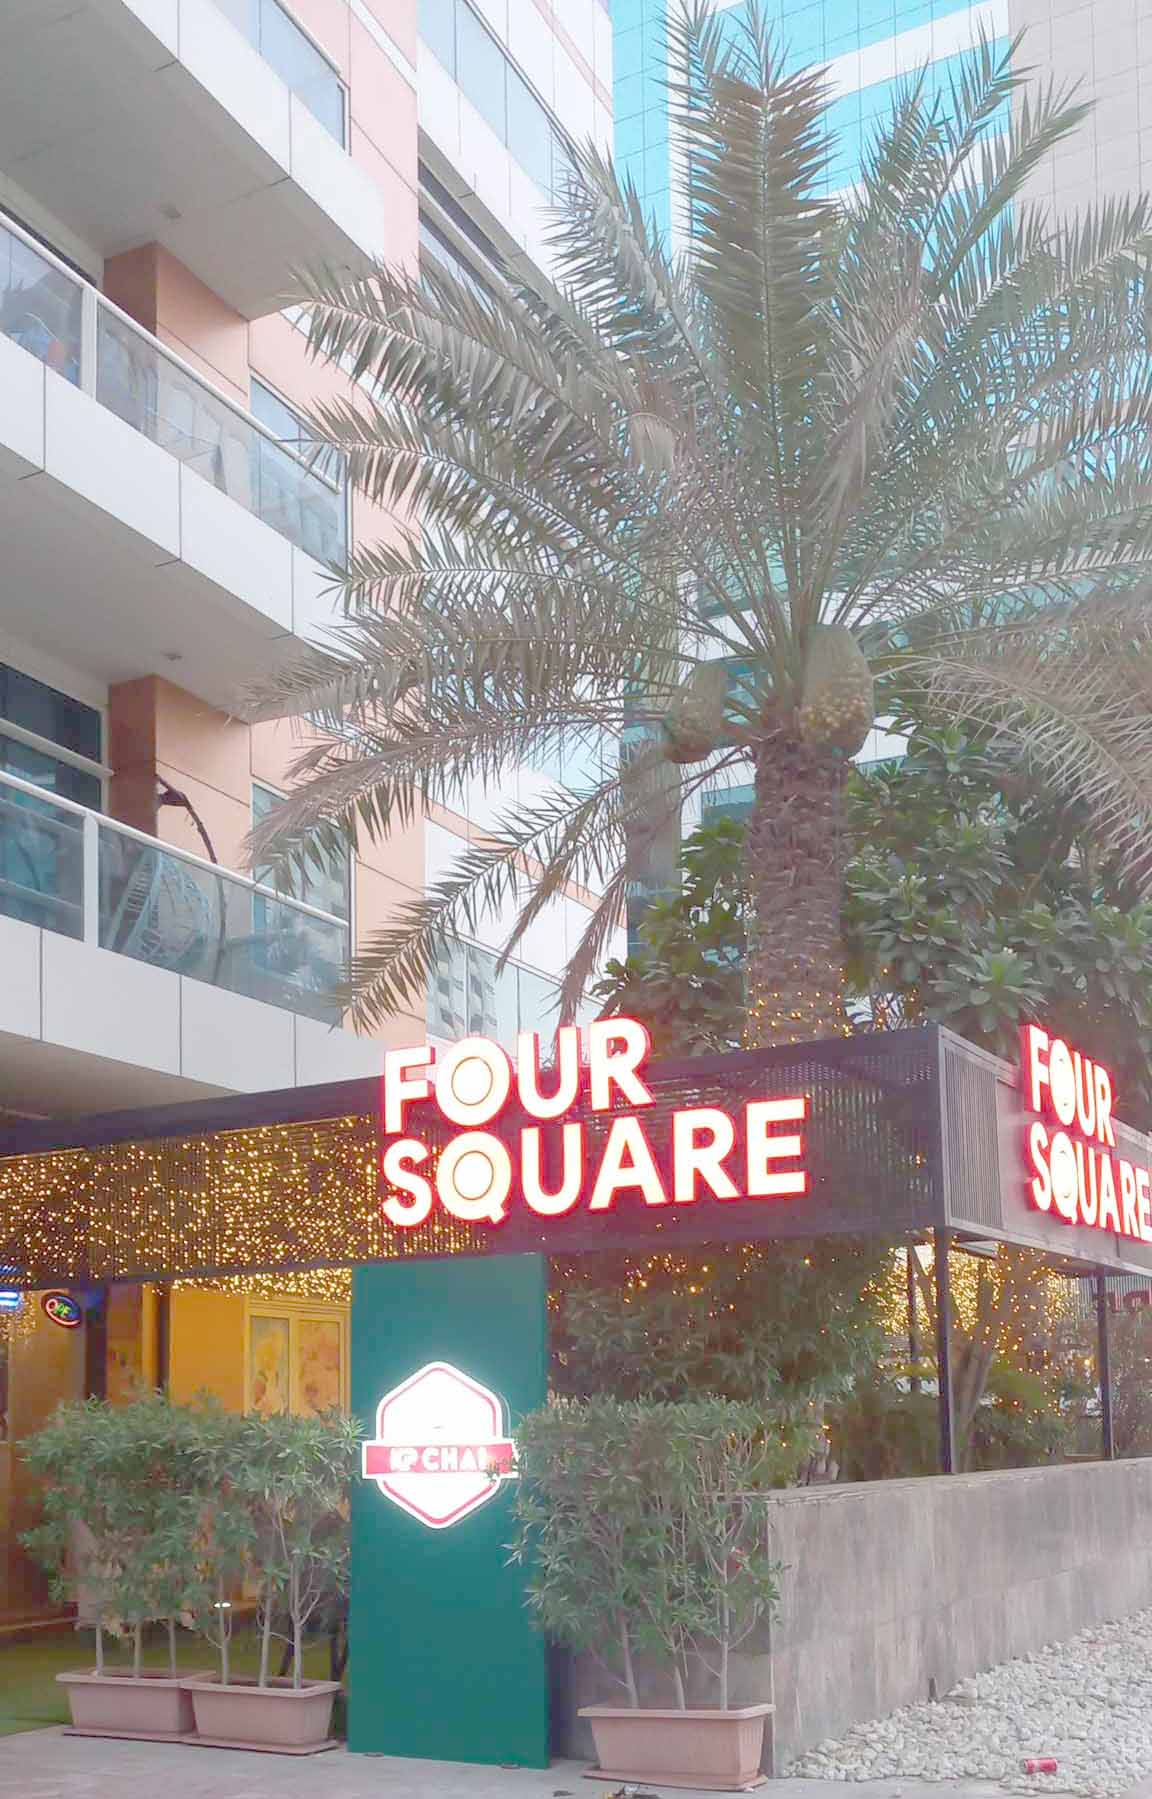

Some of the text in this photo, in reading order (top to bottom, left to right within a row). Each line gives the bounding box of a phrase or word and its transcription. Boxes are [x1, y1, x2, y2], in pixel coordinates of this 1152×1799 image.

[383, 1016, 656, 1136] FOUR
[1023, 1022, 1117, 1148] FOUR
[381, 1096, 808, 1228] SQUARE
[1027, 1120, 1152, 1243] SQUARE
[421, 1446, 489, 1472] CHAI
